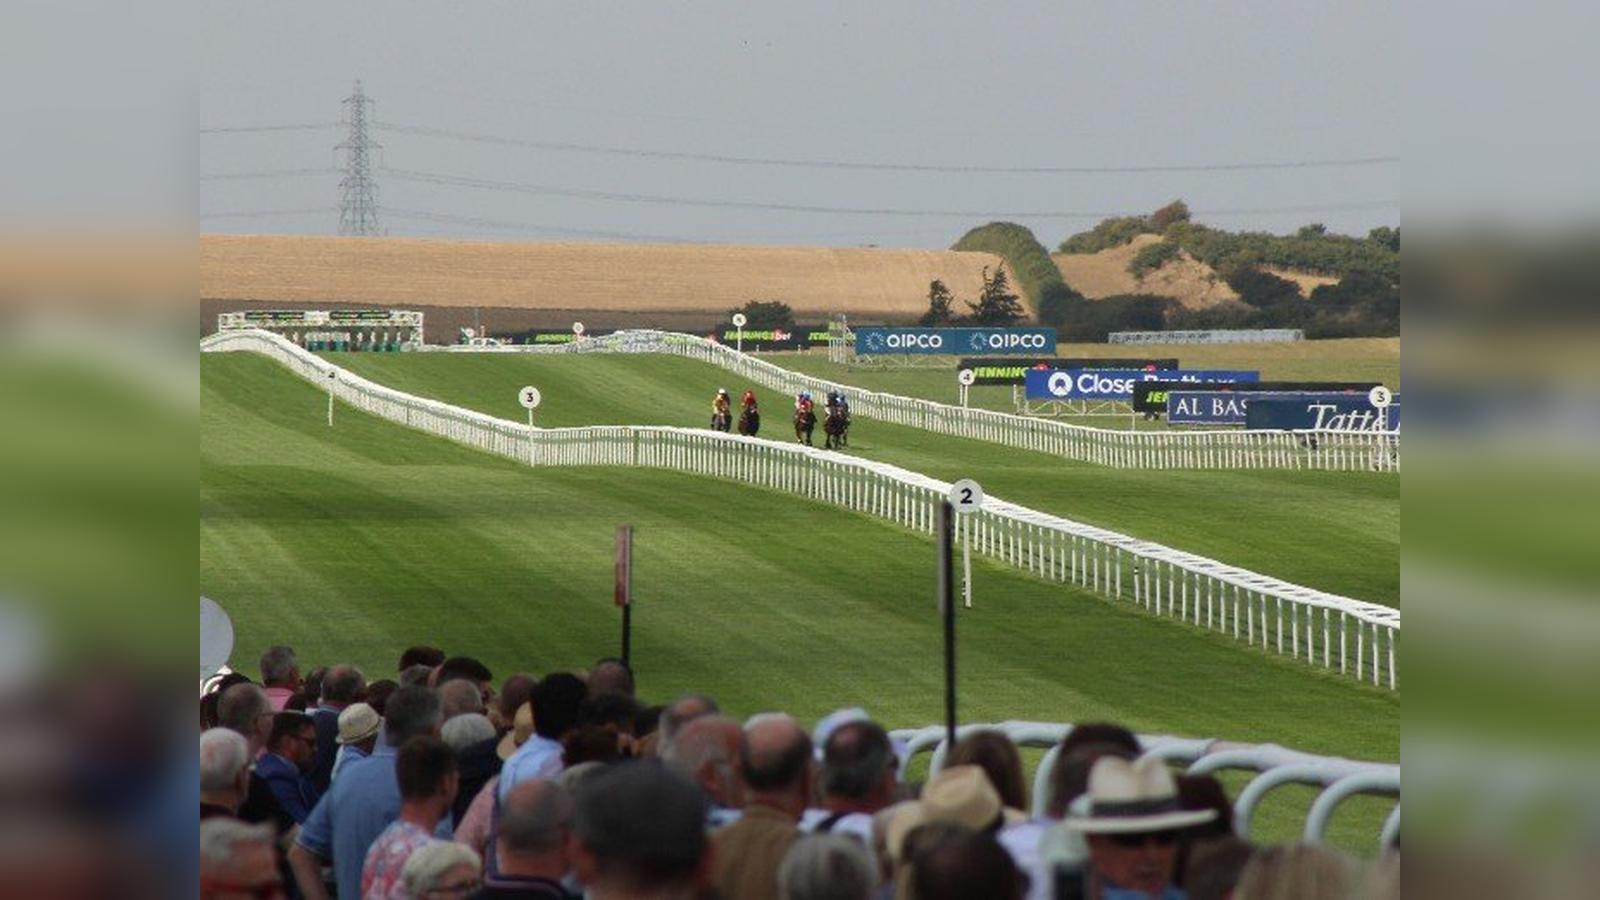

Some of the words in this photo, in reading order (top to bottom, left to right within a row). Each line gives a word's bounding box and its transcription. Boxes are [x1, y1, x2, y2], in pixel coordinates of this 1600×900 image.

[1077, 373, 1135, 394] Close
[527, 392, 534, 403] 3
[1377, 391, 1385, 403] 3
[1175, 397, 1203, 416] AL
[960, 487, 973, 504] 2
